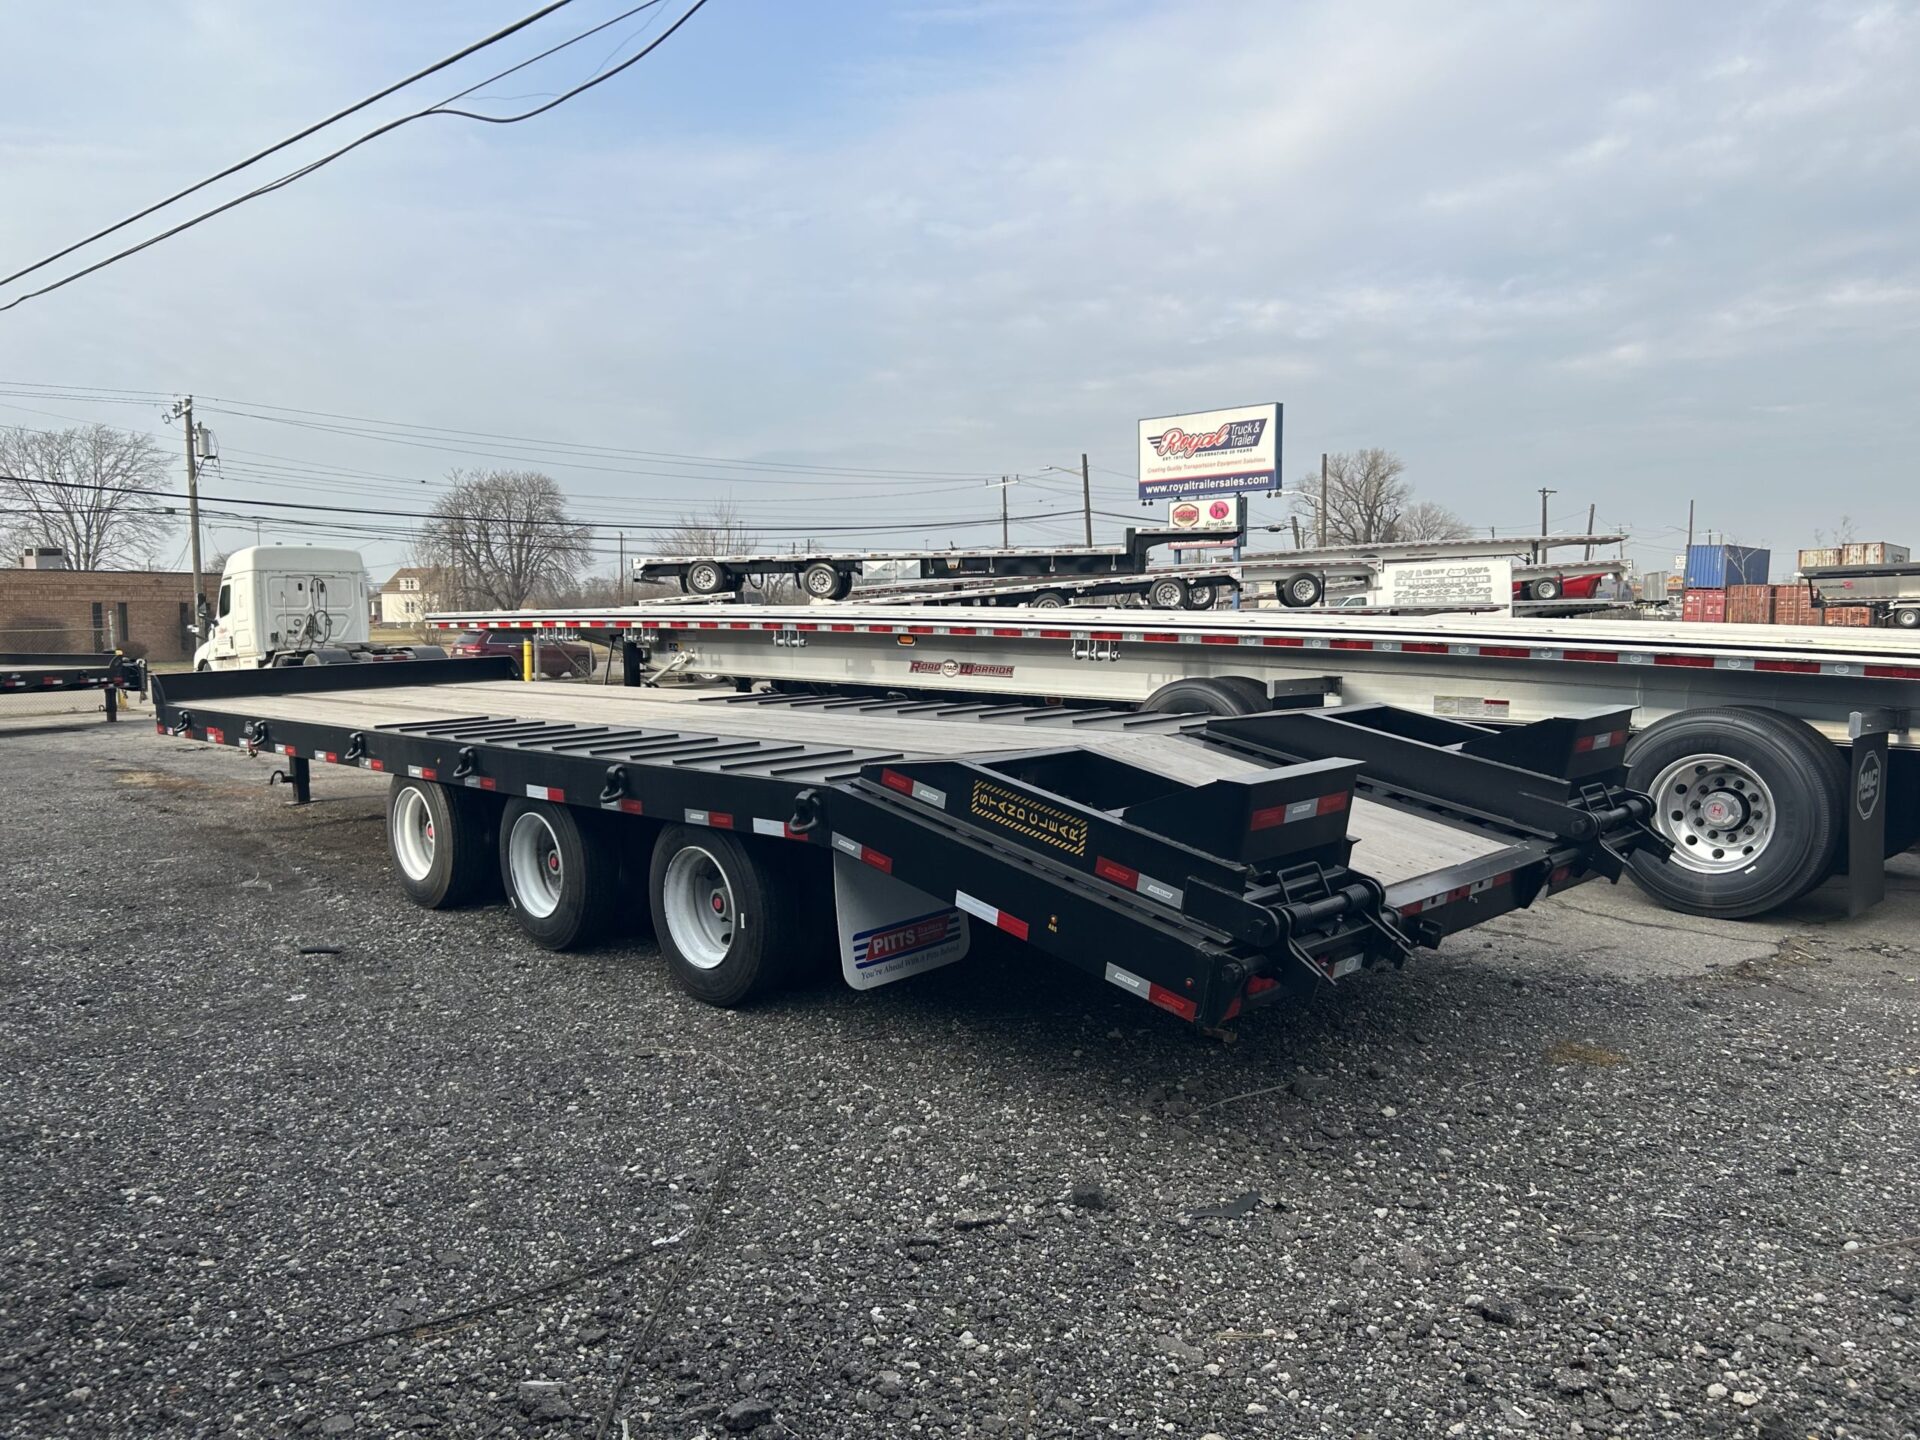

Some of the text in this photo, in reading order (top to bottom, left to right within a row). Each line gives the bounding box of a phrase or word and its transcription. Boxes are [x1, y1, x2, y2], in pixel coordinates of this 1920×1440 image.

[1231, 422, 1260, 435] Truck &
[1157, 423, 1231, 459] Royal
[1231, 435, 1256, 447] Trailer
[1167, 465, 1182, 473] Quality
[1183, 462, 1216, 470] Transportation
[1217, 459, 1242, 468] Equipment
[1145, 475, 1269, 494] www.royaltrailersales.com
[1398, 576, 1488, 586] TRUCK REPAIR
[909, 660, 941, 674] ROAD
[959, 662, 1015, 677] WARRIOR
[979, 793, 1079, 842] STAND CLEAR
[872, 929, 916, 955] PITTS
[861, 968, 883, 981] You're
[884, 959, 904, 974] Ahead
